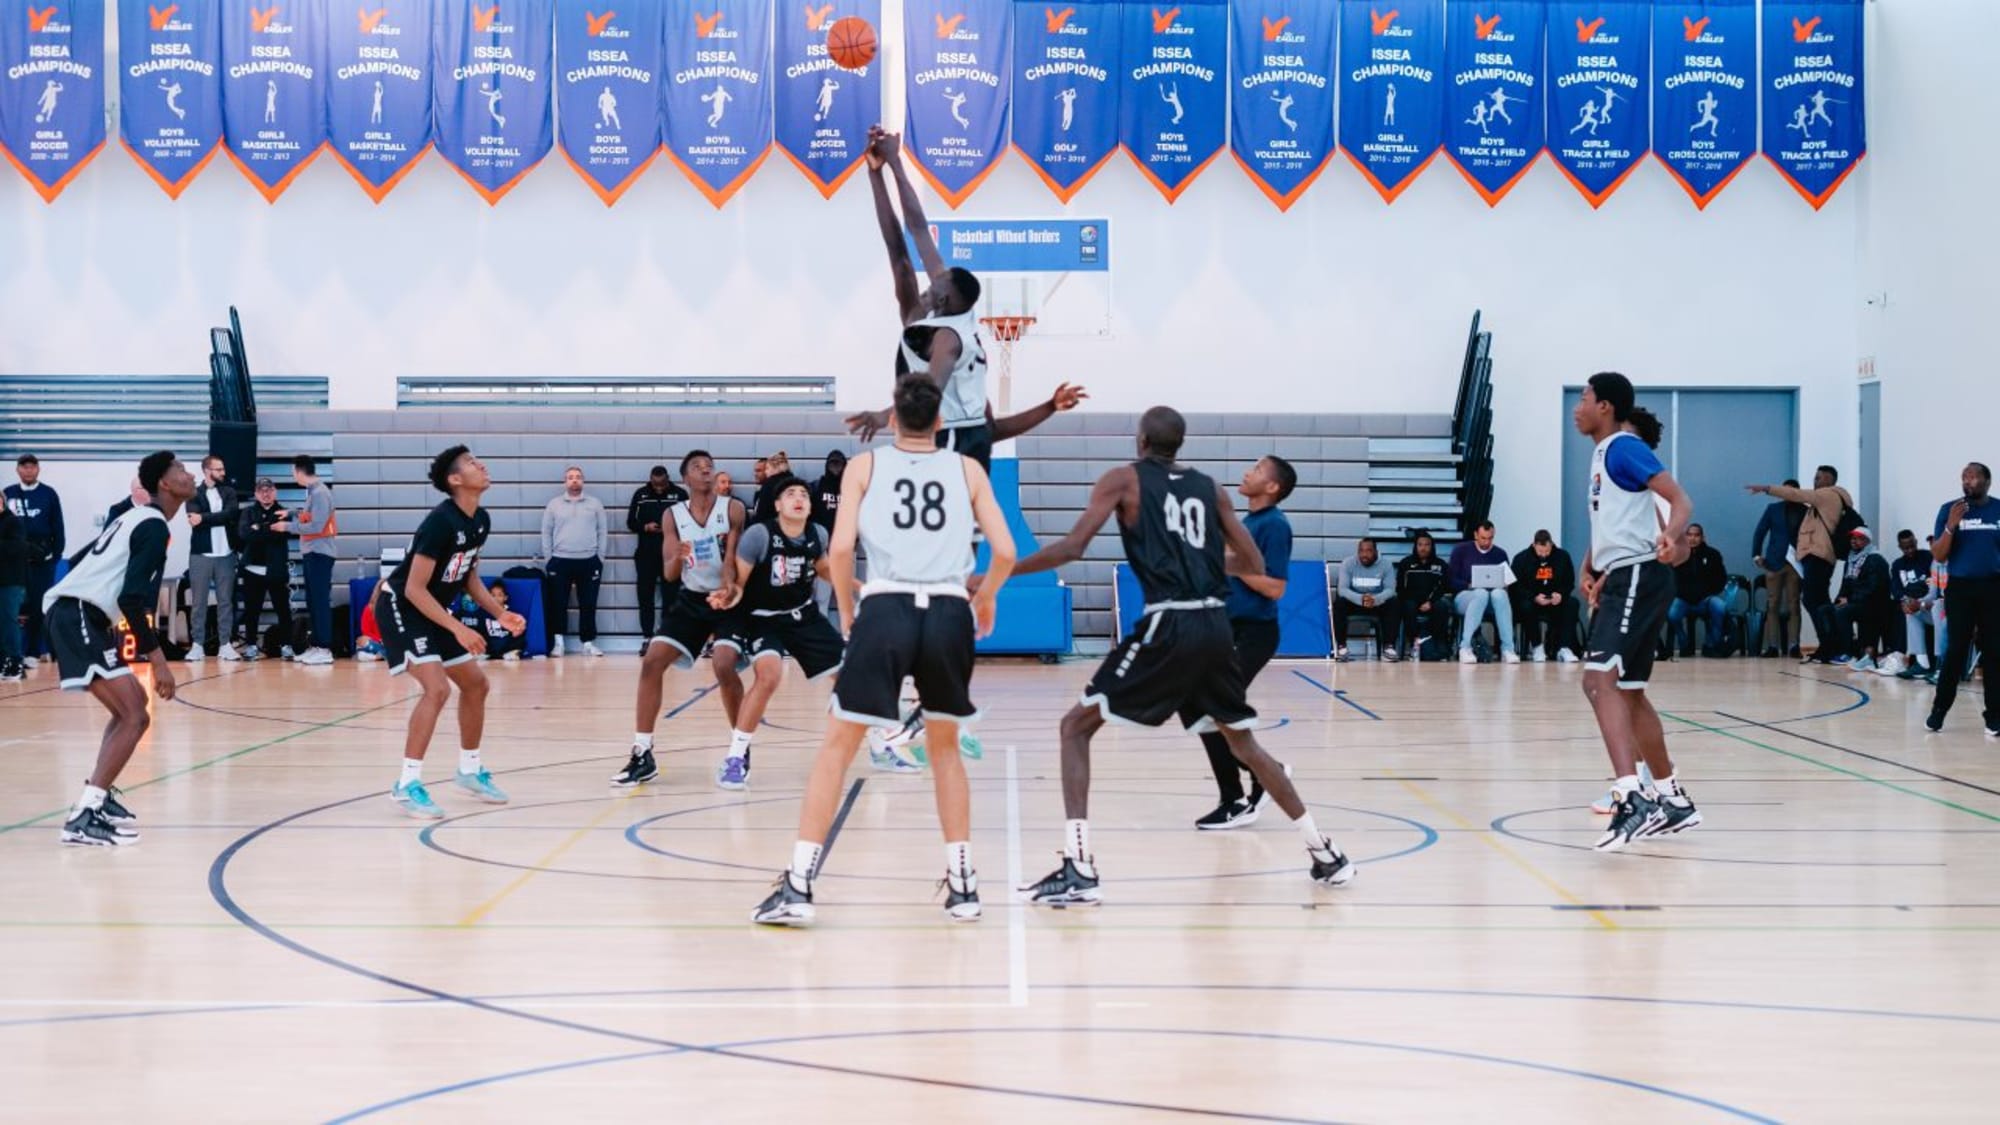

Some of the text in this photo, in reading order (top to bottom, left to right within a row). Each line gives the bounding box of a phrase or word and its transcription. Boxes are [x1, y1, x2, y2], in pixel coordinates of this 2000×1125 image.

[30, 45, 70, 58] ISSEA
[151, 43, 191, 55] ISSEA
[252, 46, 291, 58] ISSEA
[359, 47, 399, 59] ISSEA
[474, 47, 512, 58] ISSEA
[807, 45, 828, 56] ISS
[1046, 47, 1085, 59] ISSEA
[1153, 47, 1192, 58] ISSEA
[1372, 49, 1411, 60] ISSEA
[588, 51, 628, 62] ISSEA
[697, 51, 736, 62] ISSEA
[937, 53, 977, 64] ISSEA
[1264, 56, 1304, 66] ISSEA
[1475, 53, 1513, 65] ISSEA
[1577, 56, 1617, 67] ISSEA
[1685, 56, 1722, 67] ISSEA
[1795, 55, 1833, 67] ISSEA
[9, 60, 92, 79] CHAMPIONS
[130, 59, 213, 76] CHAMPIONS
[230, 62, 313, 79] CHAMPIONS
[338, 62, 421, 80] CHAMPIONS
[454, 64, 536, 81] CHAMPIONS
[1025, 63, 1107, 81] CHAMPIONS
[1133, 62, 1214, 81] CHAMPIONS
[1352, 64, 1432, 82] CHAMPIONS
[566, 65, 650, 83] CHAMPIONS
[676, 66, 758, 83] CHAMPIONS
[915, 67, 999, 86] CHAMPIONS
[1242, 71, 1326, 88] CHAMPIONS
[1456, 69, 1534, 86] CHAMPIONS
[1558, 72, 1638, 88] CHAMPIONS
[1666, 71, 1744, 89] CHAMPIONS
[1774, 71, 1854, 89] CHAMPIONS
[36, 130, 63, 139] GIRLS
[159, 128, 184, 136] BOYS
[258, 131, 285, 139] GIRLS
[365, 132, 391, 140] GIRLS
[816, 129, 840, 137] GIRLS
[1160, 133, 1183, 141] BOYS
[144, 138, 200, 147] VOLLEYBALL
[481, 137, 504, 145] BOYS
[810, 139, 846, 148] SOCCER
[943, 138, 966, 146] BOYS
[1378, 134, 1404, 142] GIRLS
[1480, 138, 1505, 146] BOYS
[31, 141, 69, 150] SOCCER
[242, 141, 300, 150] BASKETBALL
[350, 142, 406, 151] BASKETBALL
[1054, 144, 1078, 152] GOLF
[1156, 143, 1188, 152] TENNIS
[1270, 140, 1297, 148] GIRLS
[1364, 144, 1419, 152] BASKETBALL
[1582, 140, 1610, 148] GIRLS
[1692, 141, 1715, 149] BOYS
[1802, 141, 1827, 149] BOYS
[466, 147, 520, 156] VOLLEYBALL
[590, 146, 627, 154] SOCCER
[689, 146, 746, 154] BASKETBALL
[926, 148, 983, 156] VOLLEYBALL
[1255, 150, 1312, 158] VOLLEYBALL
[1459, 147, 1490, 156] TRACK
[1500, 148, 1526, 157] FIELD
[1562, 149, 1592, 158] TRACK
[1604, 150, 1630, 158] FIELD
[1698, 151, 1740, 159] COUNTRY
[1781, 151, 1812, 160] TRACK
[1823, 151, 1848, 159] FIELD
[952, 230, 1060, 243] Basketball Without Borders
[893, 478, 946, 532] 38
[1164, 492, 1206, 549] 40
